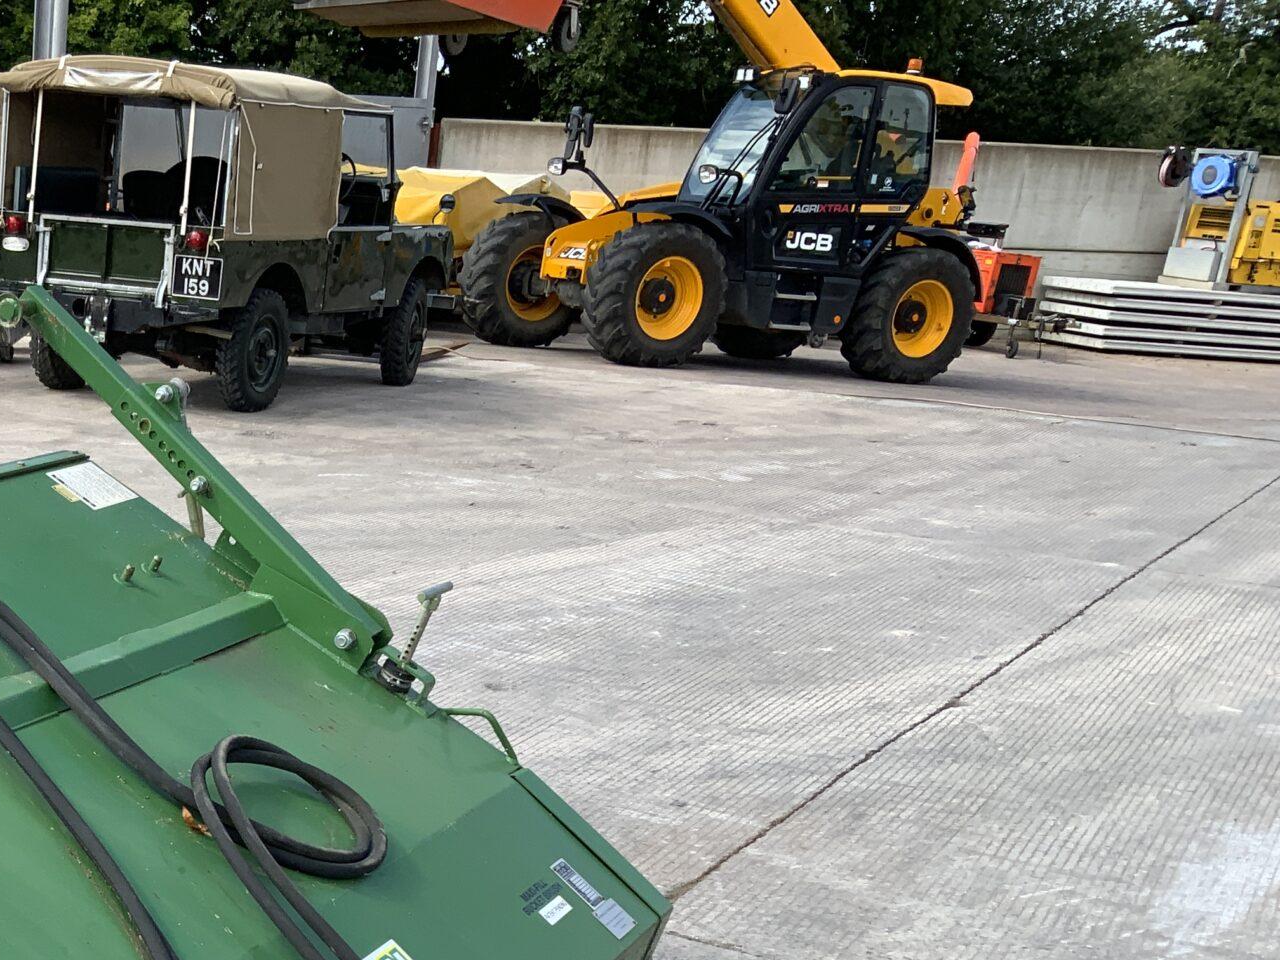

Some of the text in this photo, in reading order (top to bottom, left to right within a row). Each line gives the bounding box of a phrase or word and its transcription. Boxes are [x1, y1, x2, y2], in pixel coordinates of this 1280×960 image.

[792, 204, 849, 214] AGRIXTRA
[785, 231, 833, 252] JCB
[181, 257, 214, 277] KNT
[183, 277, 209, 296] 159
